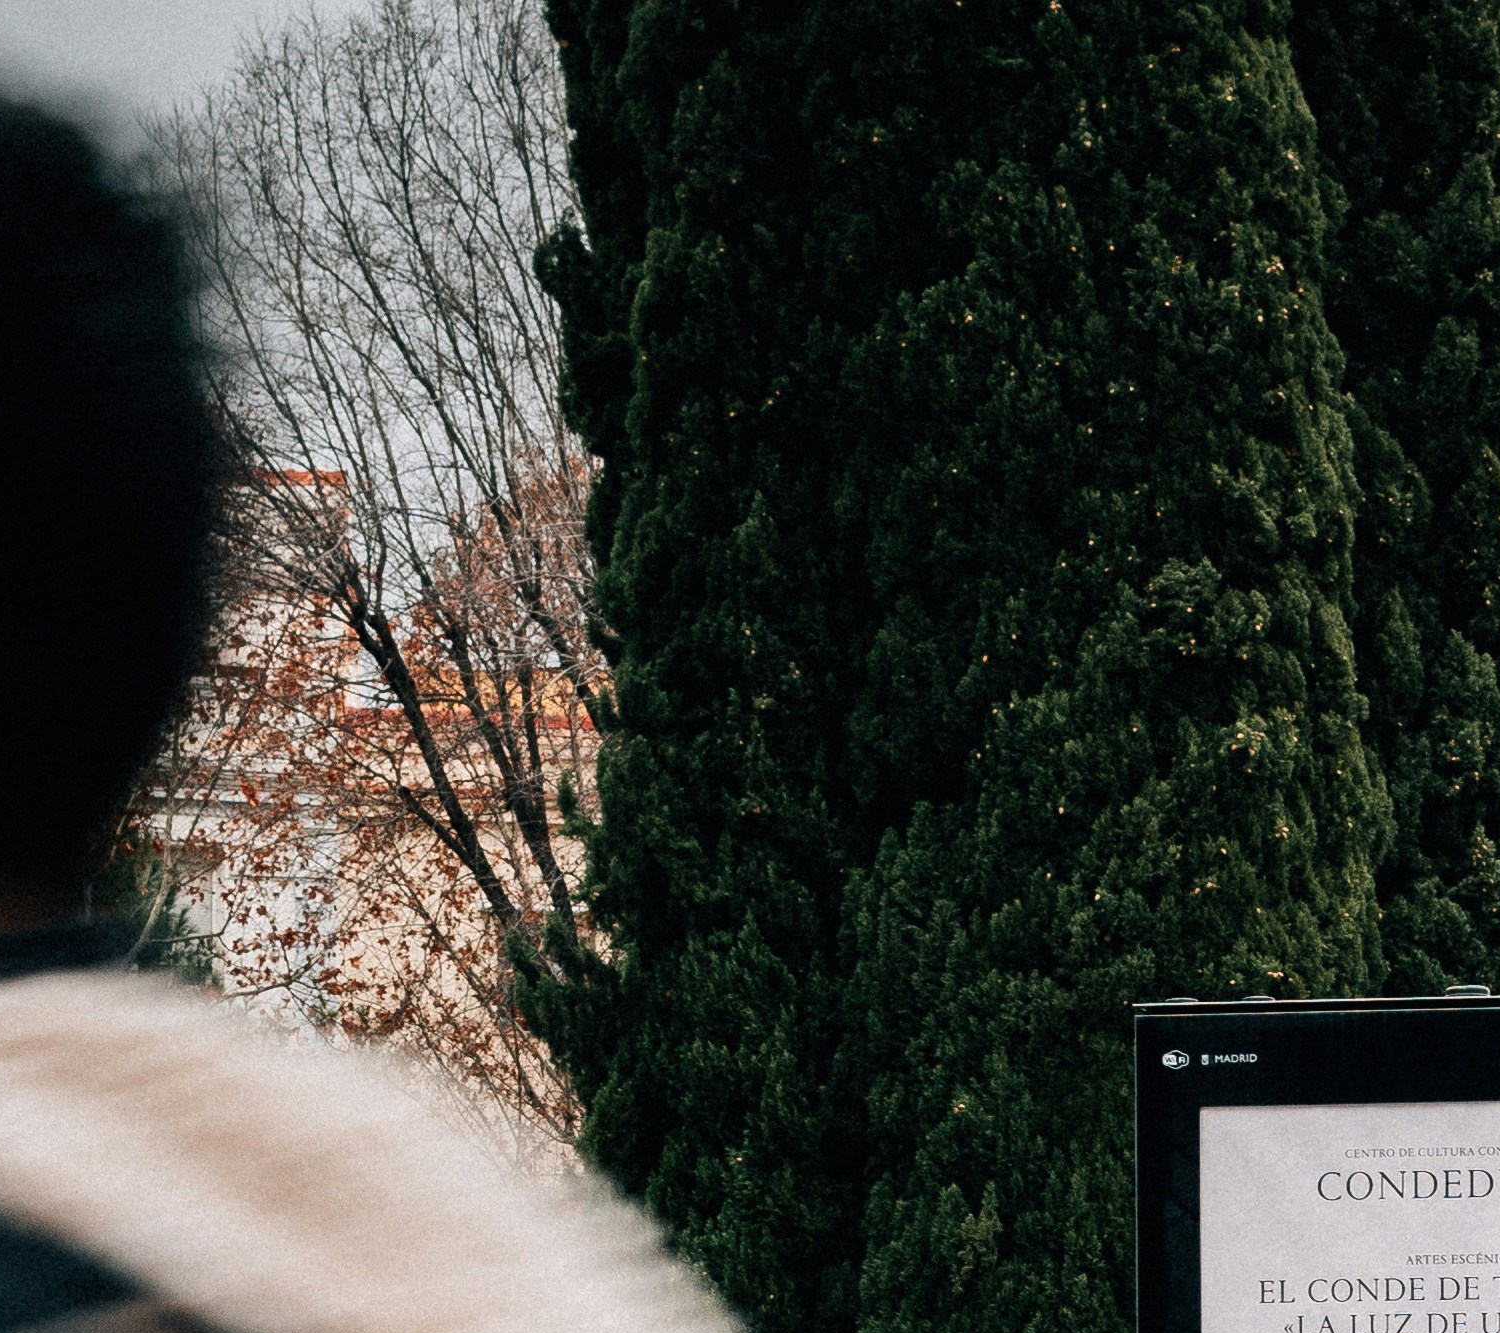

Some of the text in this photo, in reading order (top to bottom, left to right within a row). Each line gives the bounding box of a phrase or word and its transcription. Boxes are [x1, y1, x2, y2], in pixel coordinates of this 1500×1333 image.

[1214, 1053, 1258, 1064] MADRID
[1344, 1148, 1396, 1159] CENTRO
[1398, 1147, 1414, 1158] DE
[1417, 1147, 1475, 1157] CULTURA
[1407, 1254, 1447, 1265] ARTES
[1259, 1279, 1296, 1304] EL
[1307, 1277, 1425, 1303] CONDE
[1439, 1276, 1480, 1301] DE
